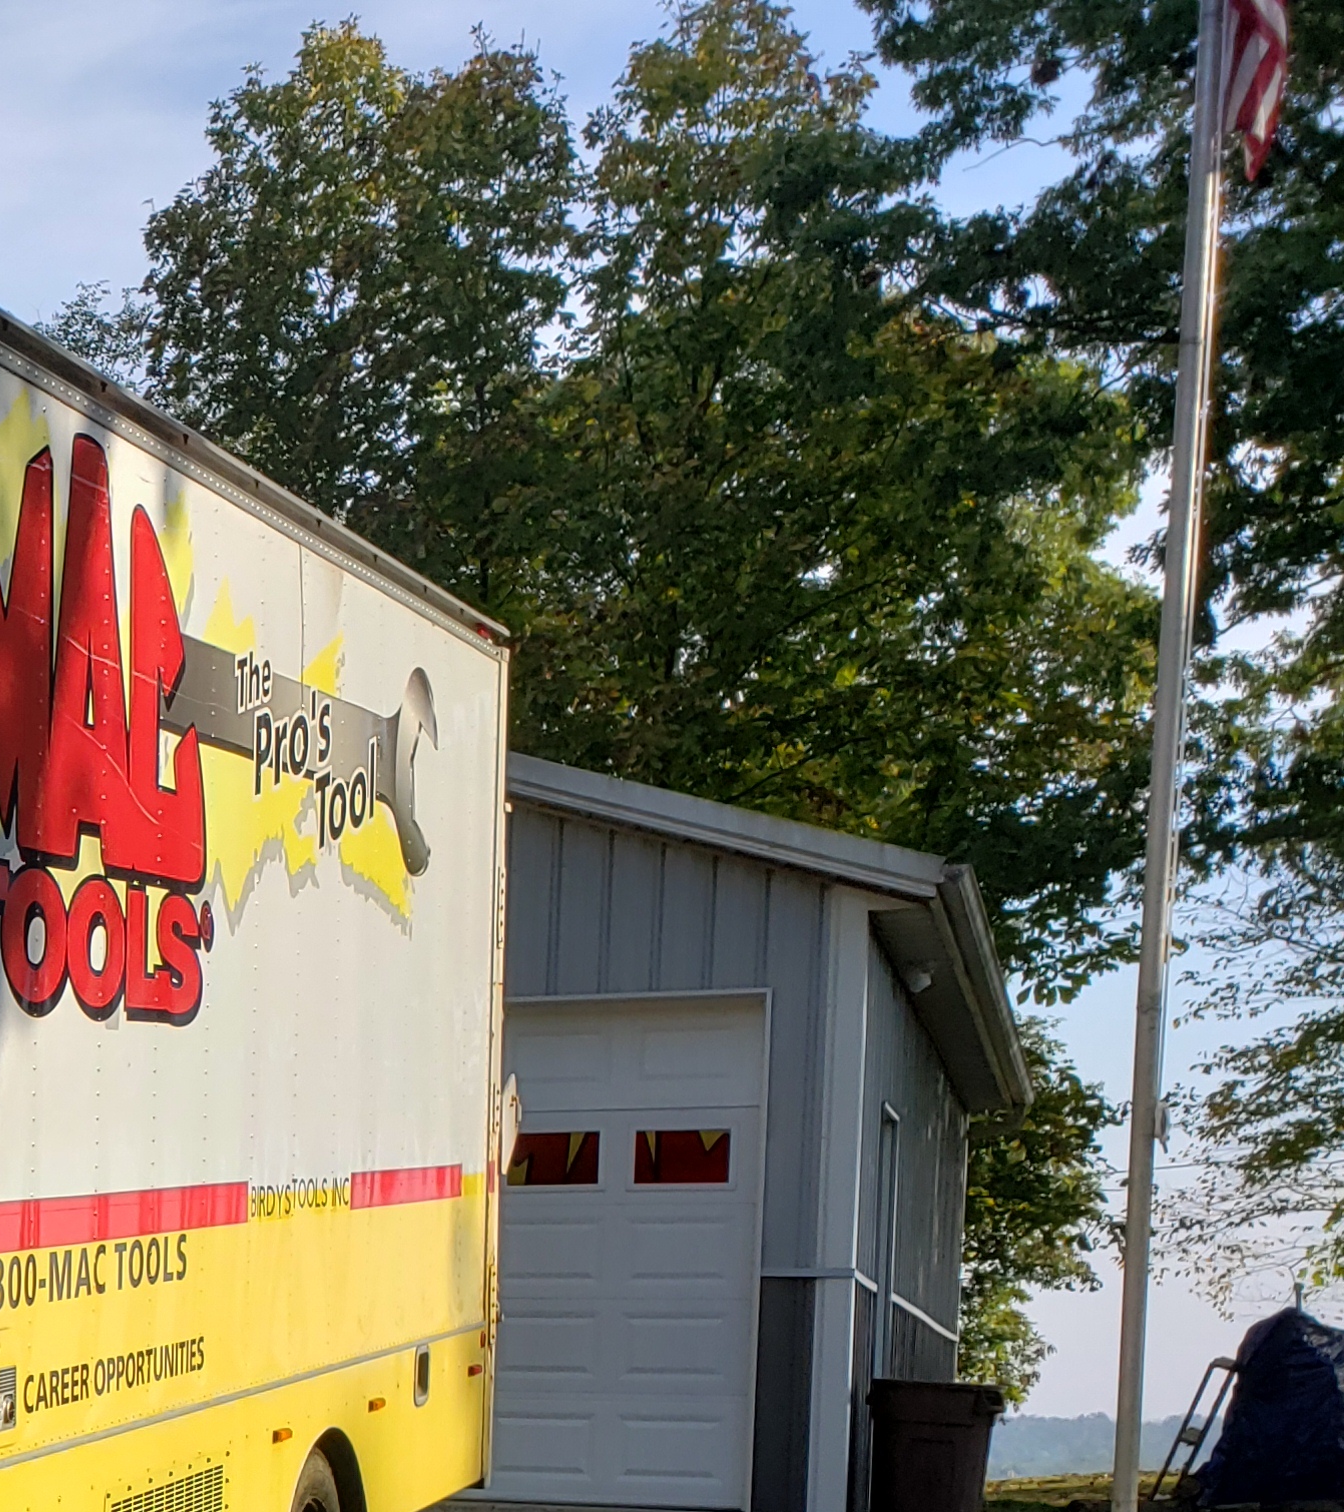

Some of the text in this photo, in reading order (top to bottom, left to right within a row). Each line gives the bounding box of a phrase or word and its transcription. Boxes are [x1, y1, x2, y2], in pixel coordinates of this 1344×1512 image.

[236, 651, 272, 713] The
[254, 689, 330, 796] Pro's
[314, 737, 377, 850] Tool
[332, 1177, 349, 1207] INC
[114, 1234, 187, 1291] TOOLS
[23, 1363, 89, 1414] CAREER
[94, 1336, 205, 1397] OPPORTUNITIES
